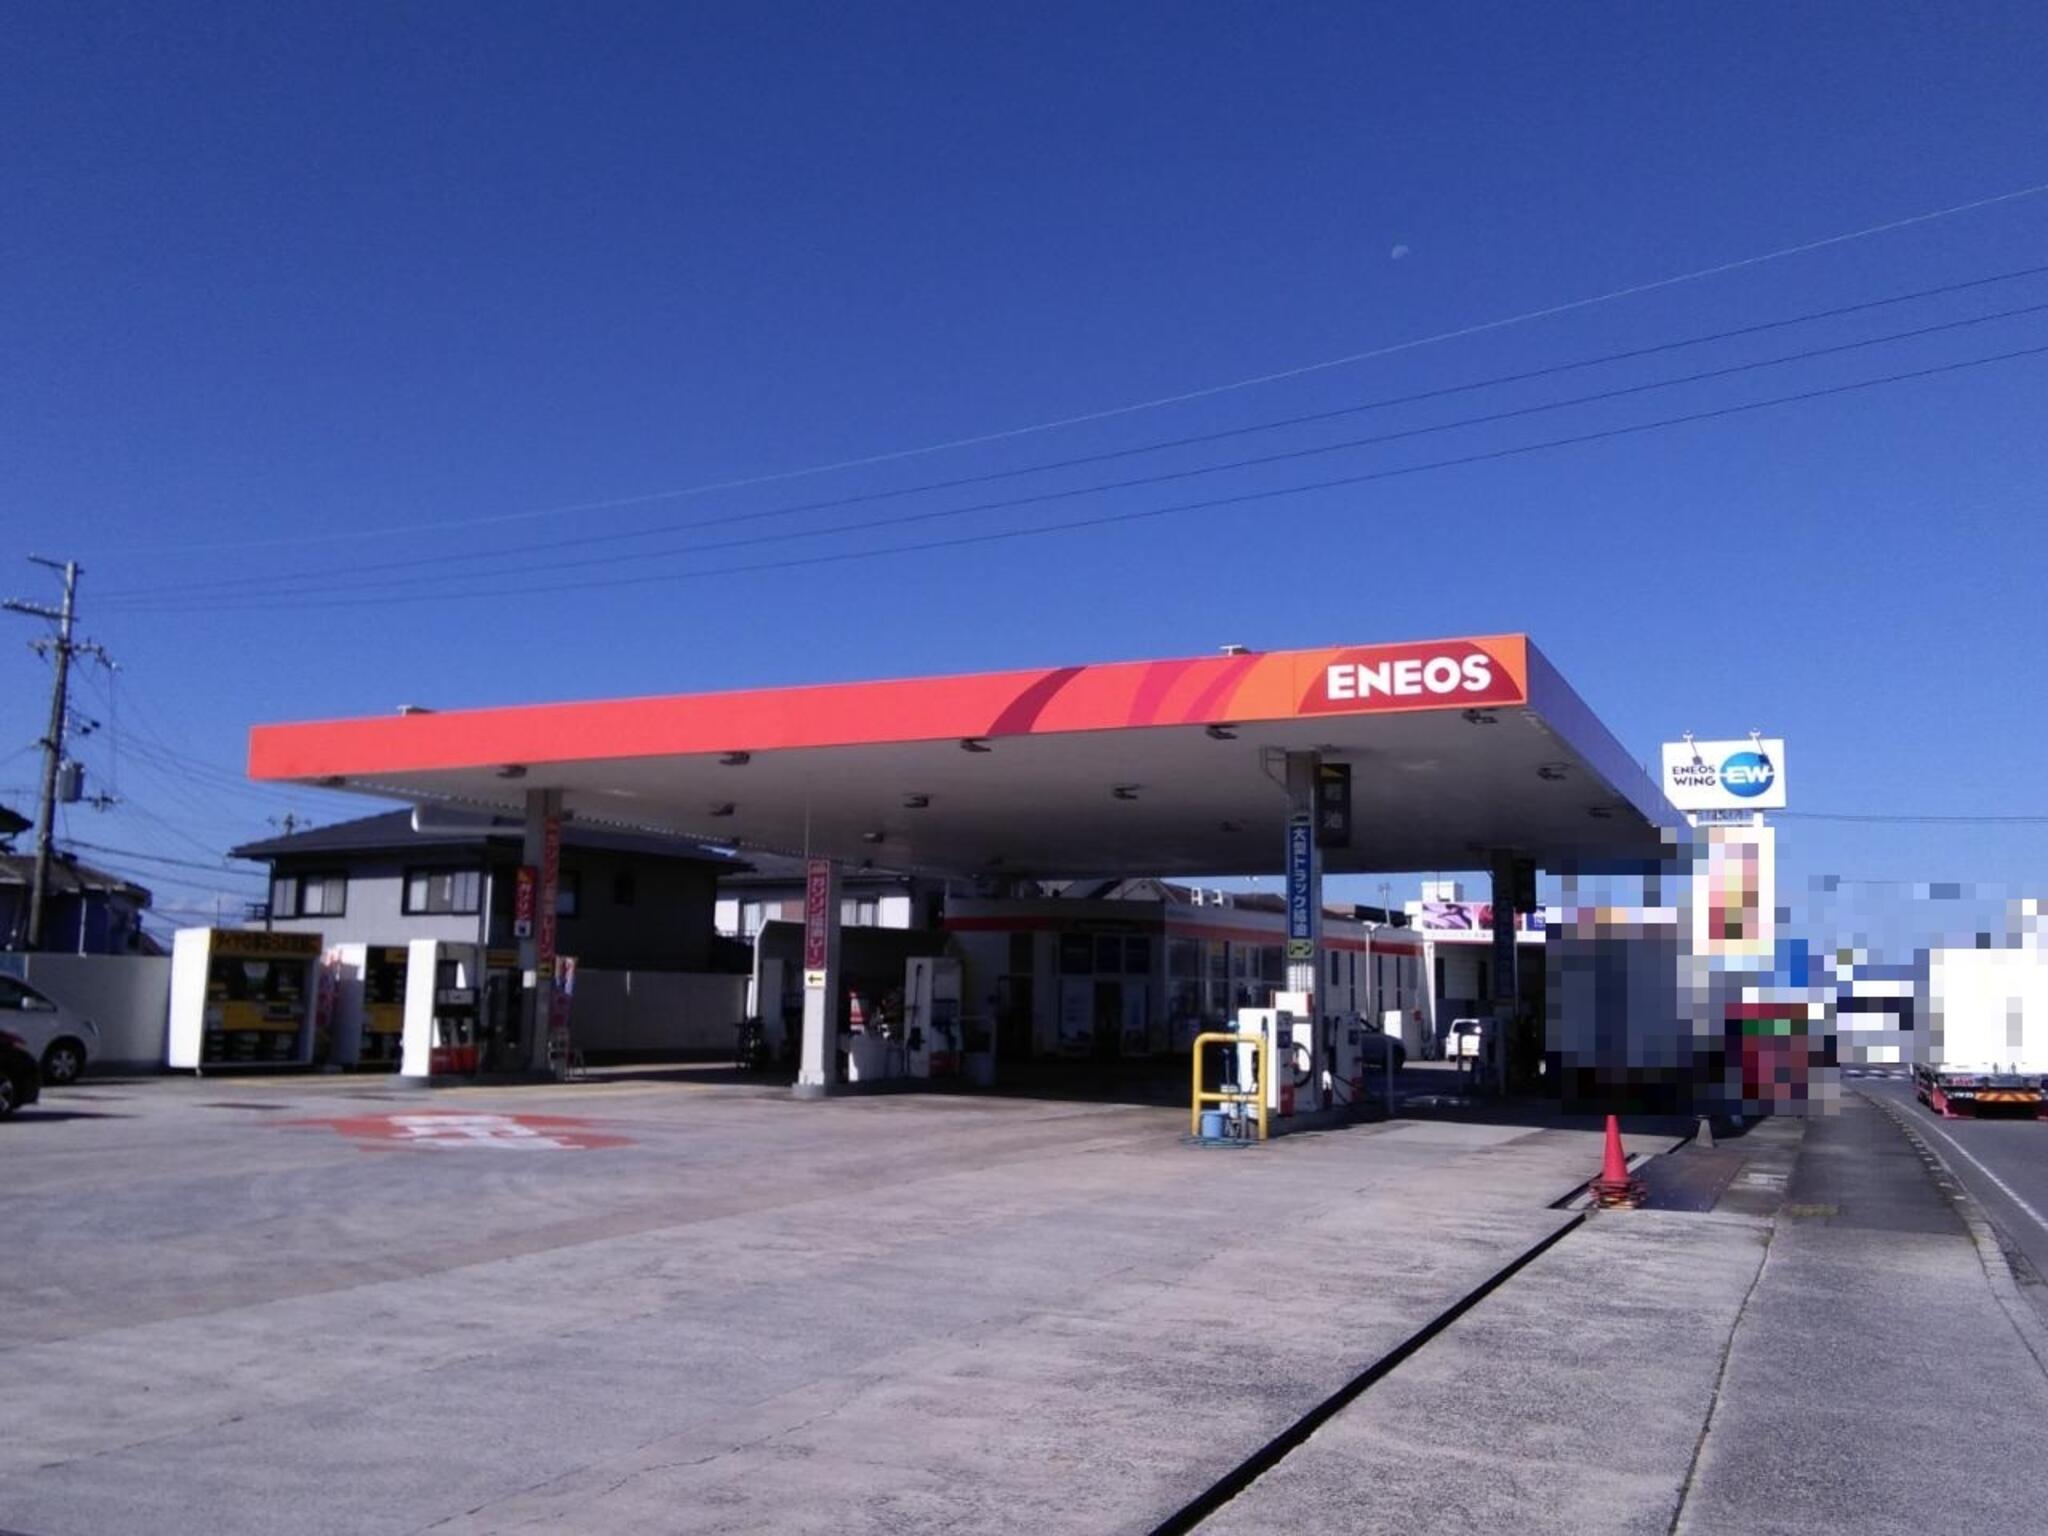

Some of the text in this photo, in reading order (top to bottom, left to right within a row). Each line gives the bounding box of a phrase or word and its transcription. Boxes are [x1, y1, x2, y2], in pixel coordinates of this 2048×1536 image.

[1327, 654, 1492, 700] ENEOS
[1672, 765, 1716, 775] ENEOS
[1726, 765, 1769, 784] EW
[1674, 775, 1716, 787] WING
